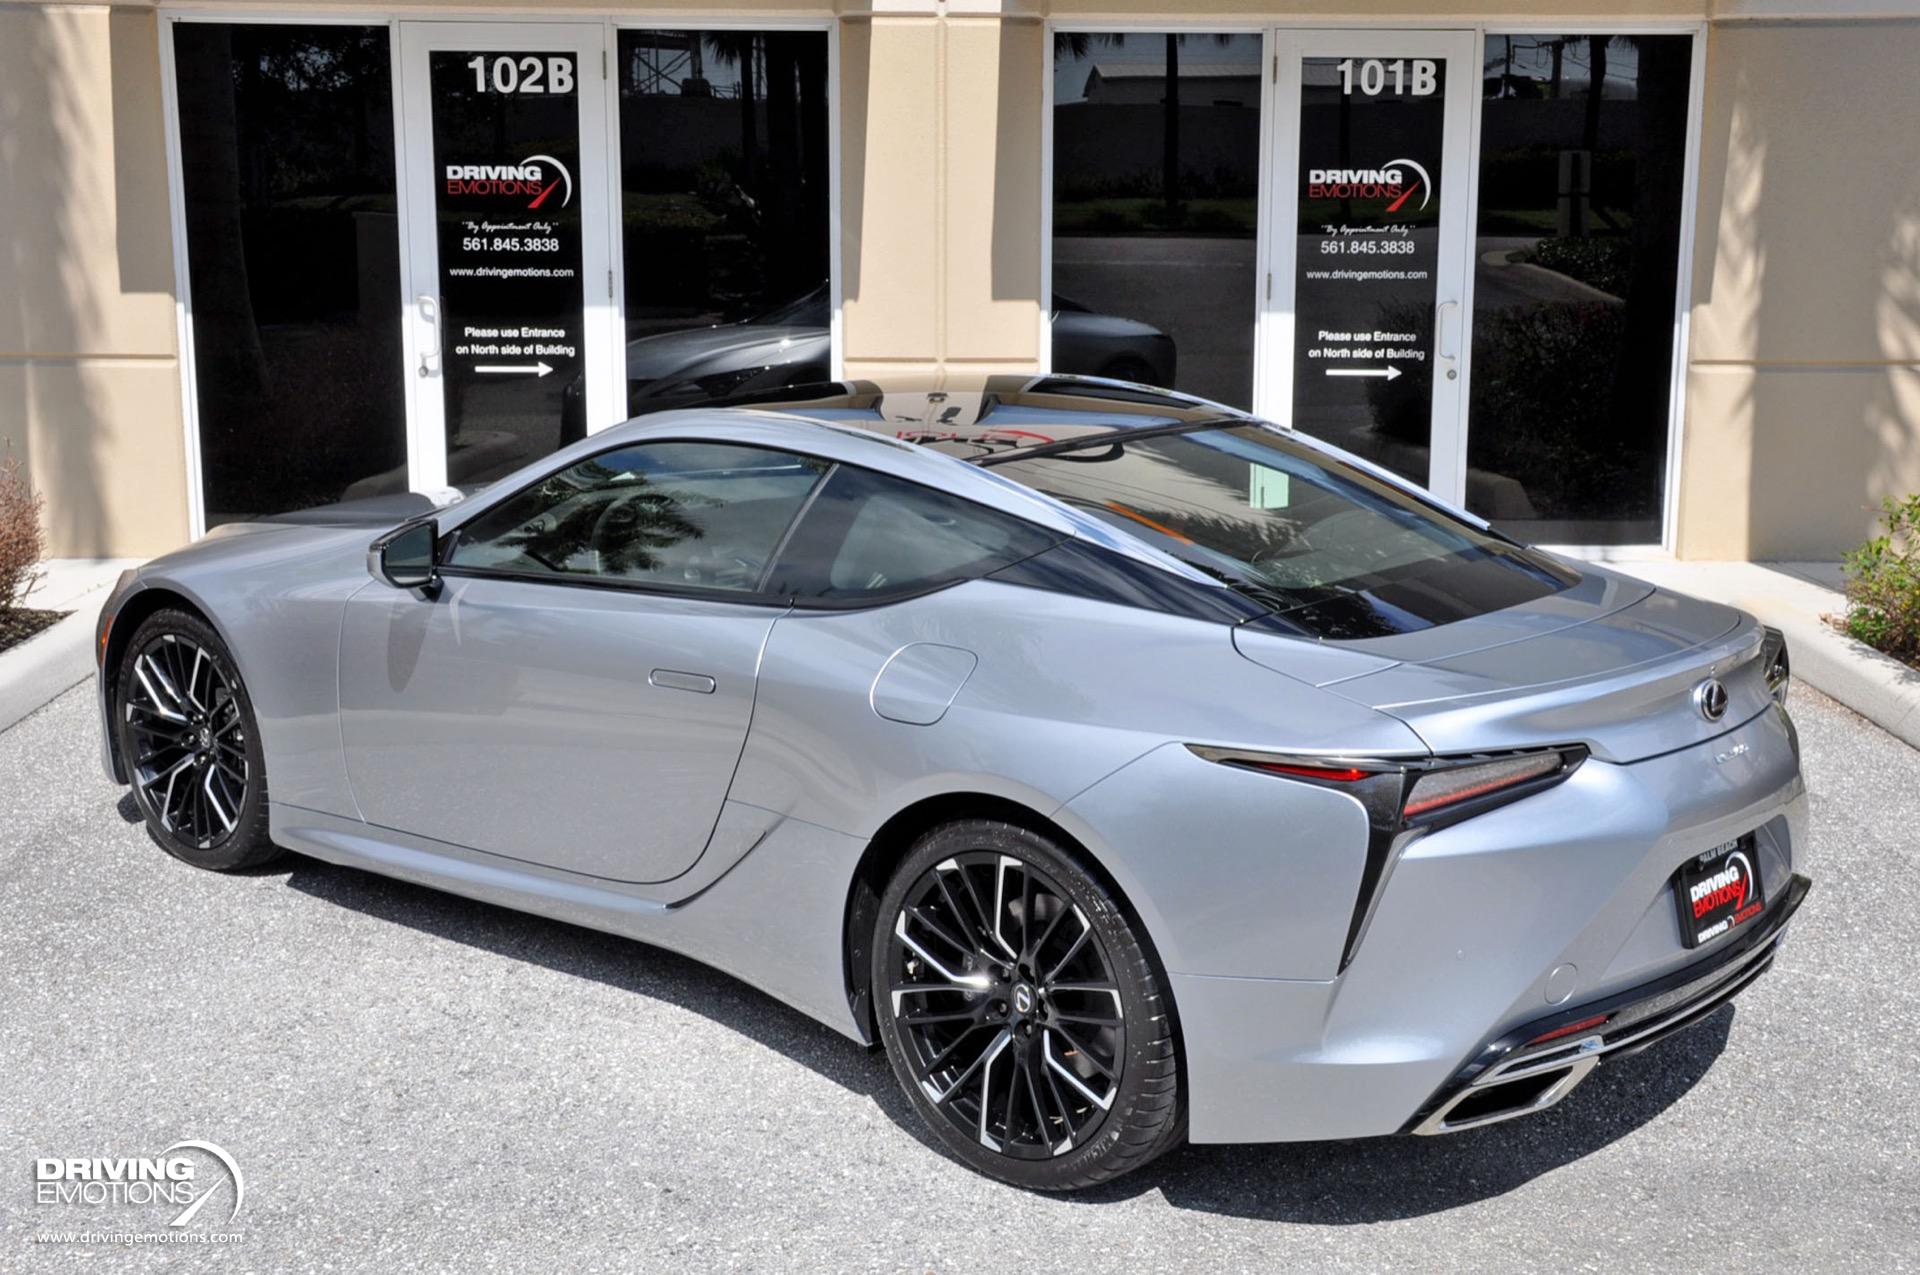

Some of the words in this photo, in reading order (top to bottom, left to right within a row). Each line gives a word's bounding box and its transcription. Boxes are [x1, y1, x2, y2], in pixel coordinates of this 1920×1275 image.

[467, 56, 574, 94] 102B
[1336, 59, 1437, 96] 101B
[446, 165, 542, 181] DRIVING
[1309, 169, 1402, 185] DRIVING
[447, 180, 542, 195] EMOTIONS
[1309, 184, 1402, 199] EMOTIONS
[481, 221, 532, 232] Appointment
[1340, 224, 1389, 236] Appointment
[463, 238, 560, 251] 561.845.3838
[1320, 241, 1415, 254] 561.845.3838
[449, 266, 574, 279] www.drivingemotions.com
[1306, 269, 1428, 281] www.drivingemotions.com
[464, 327, 499, 338] Please
[500, 328, 519, 338] use
[521, 327, 566, 338] Entrance
[1318, 330, 1352, 341] Please
[1353, 332, 1372, 341] use
[1373, 331, 1417, 342] Entrance
[455, 345, 469, 355] on
[471, 344, 499, 355] North
[501, 344, 522, 355] side
[523, 344, 534, 355] of
[535, 344, 576, 358] Building
[1308, 349, 1321, 358] on
[1323, 347, 1351, 358] North
[1352, 347, 1373, 359] side
[1374, 348, 1385, 359] of
[1386, 348, 1425, 361] Building
[1690, 866, 1740, 903] DRIVING
[1693, 881, 1742, 919] EMOTIONS
[1697, 920, 1728, 943] DRIVING
